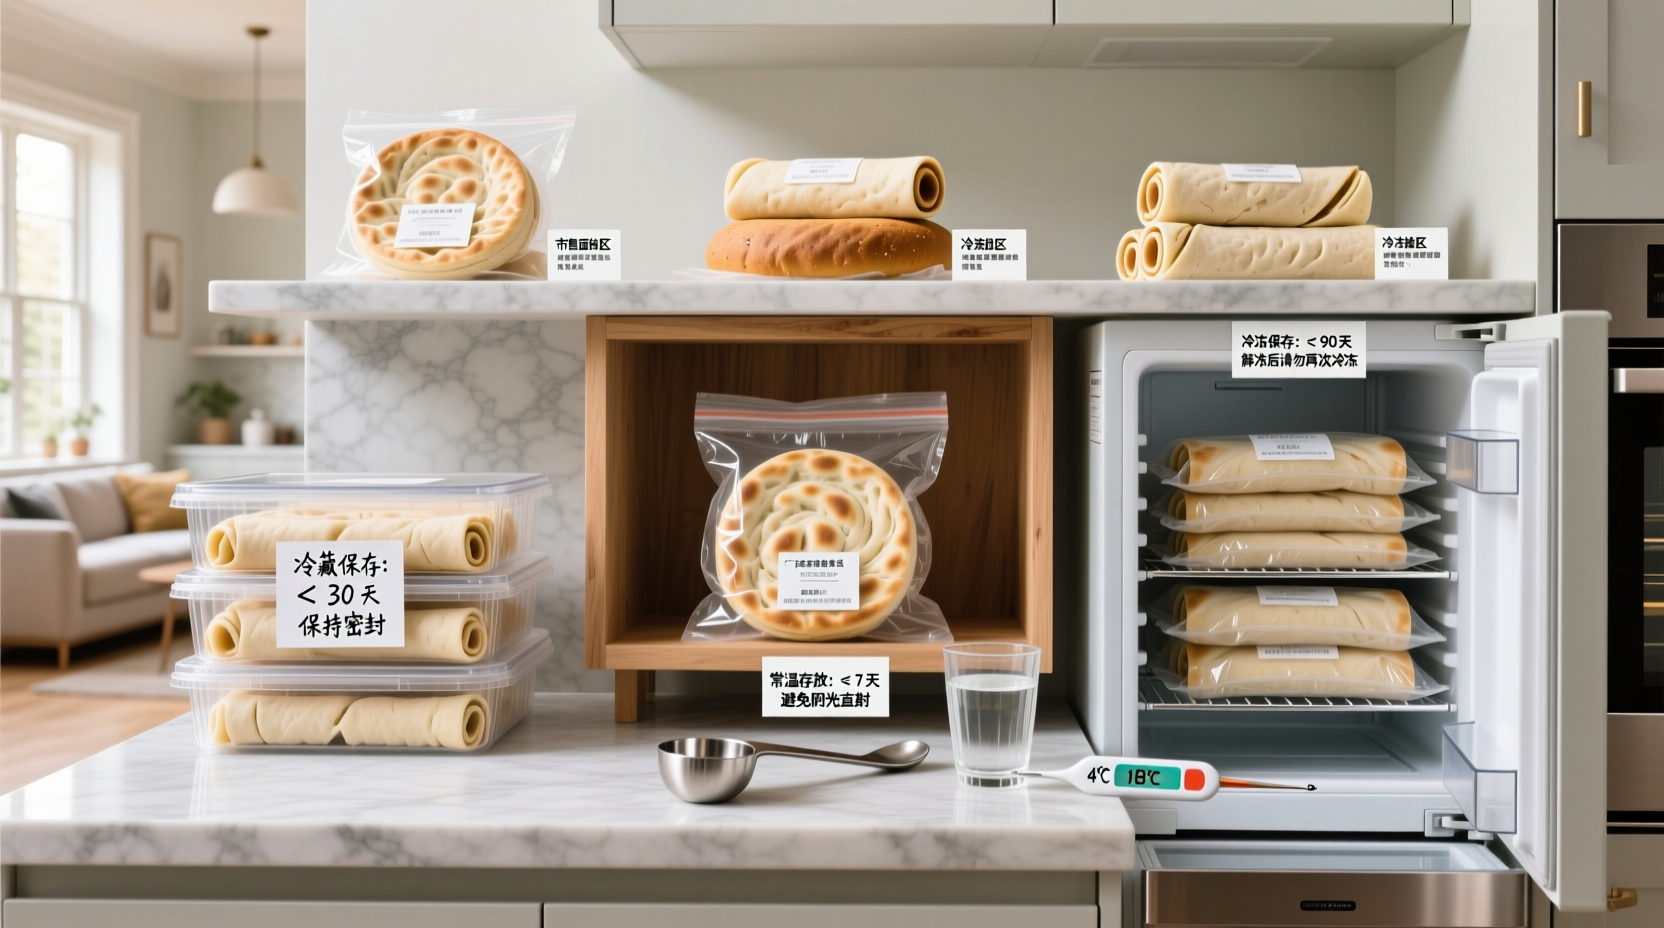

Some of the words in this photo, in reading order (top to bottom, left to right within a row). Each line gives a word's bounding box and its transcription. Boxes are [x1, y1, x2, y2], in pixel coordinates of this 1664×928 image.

[294, 551, 387, 577] 冷藏保存:
[299, 611, 385, 638] 保持密封
